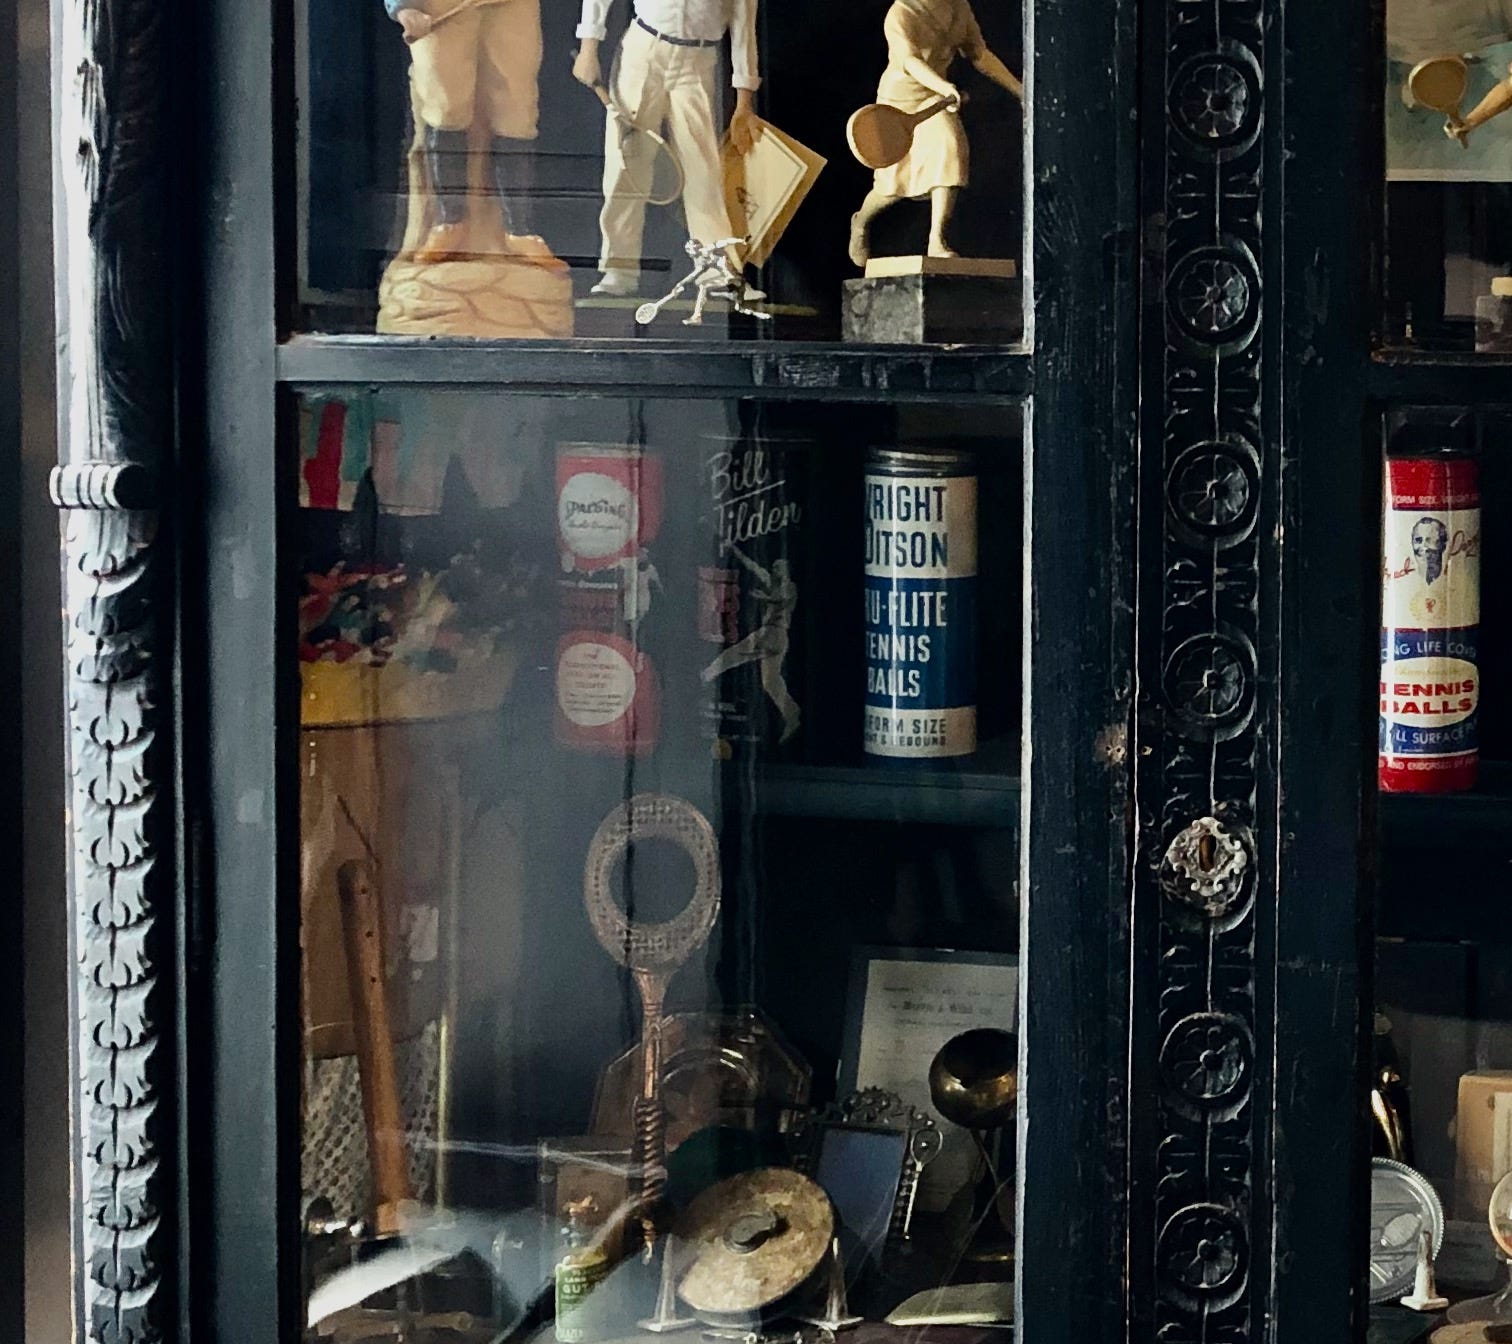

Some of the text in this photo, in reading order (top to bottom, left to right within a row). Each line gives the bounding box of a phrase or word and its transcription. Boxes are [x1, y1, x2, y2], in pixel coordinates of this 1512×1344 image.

[707, 450, 770, 499] Bill
[713, 501, 800, 557] Tilden
[1416, 640, 1442, 655] LIFE
[868, 666, 921, 697] BALLS
[912, 718, 947, 735] SIZE
[892, 735, 946, 747] EBOUND
